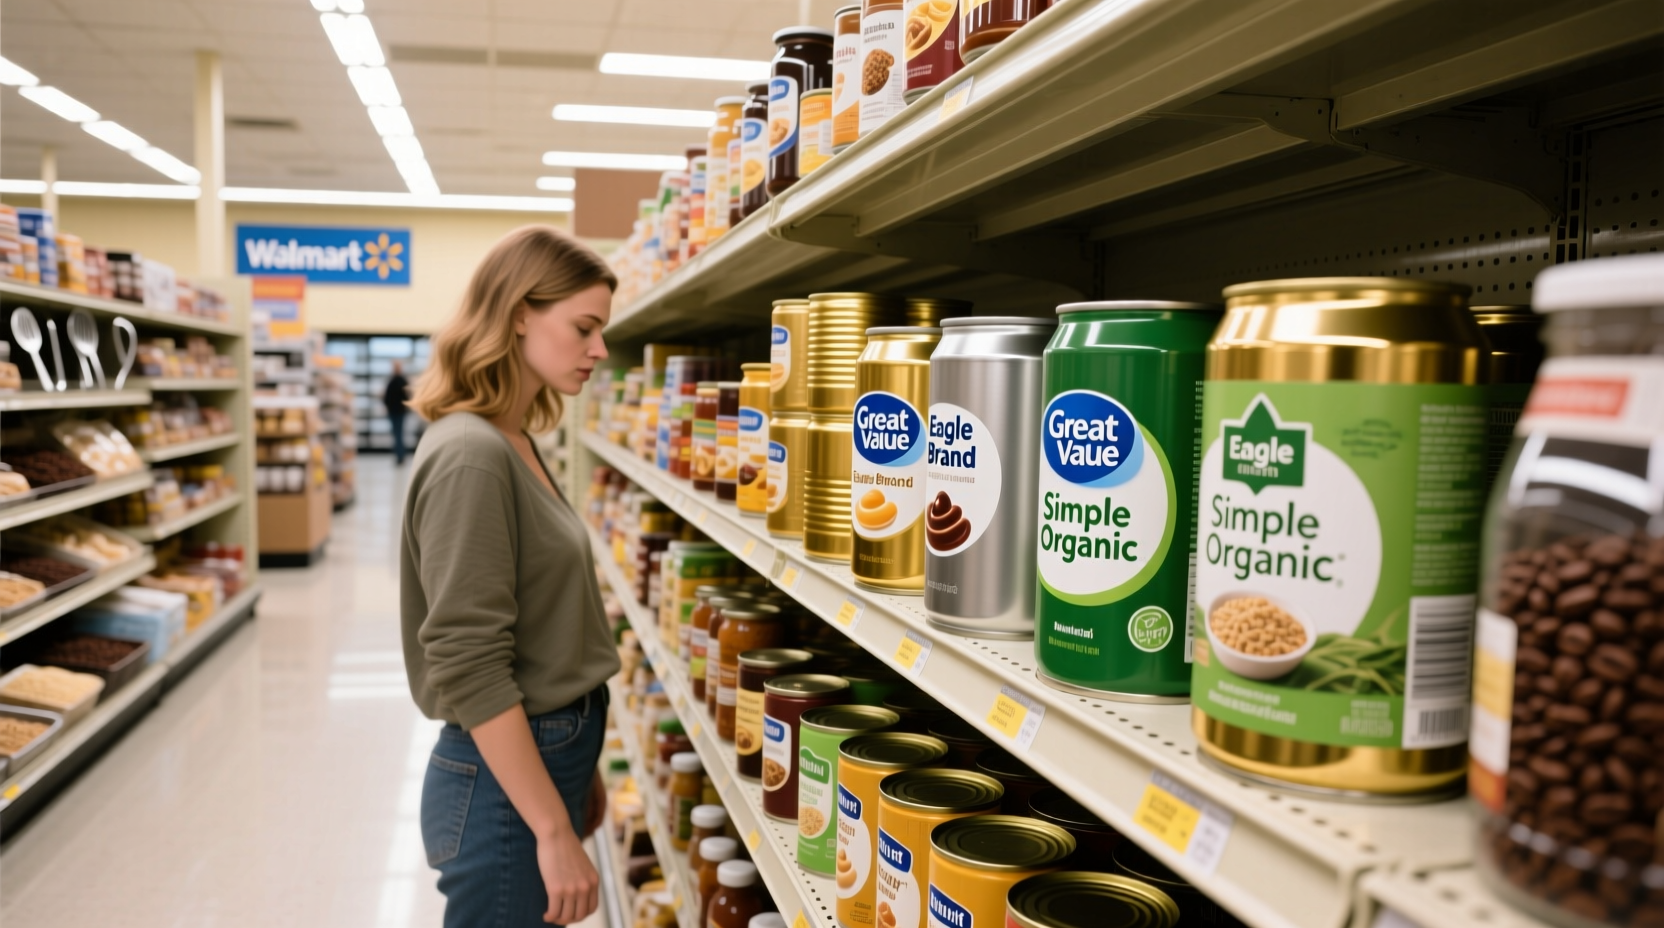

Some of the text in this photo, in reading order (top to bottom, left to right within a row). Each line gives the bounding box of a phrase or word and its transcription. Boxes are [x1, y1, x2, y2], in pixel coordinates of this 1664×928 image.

[244, 238, 363, 272] Walmart
[856, 405, 909, 431] Great
[930, 414, 973, 446] Eagle
[1048, 409, 1119, 442] Great
[861, 429, 910, 451] Value
[928, 441, 977, 469] Brand
[1229, 435, 1294, 469] Eagle
[1043, 491, 1131, 532] Simple
[1211, 493, 1320, 544] Simple
[1041, 523, 1138, 563] Organic
[1206, 532, 1334, 581] Organic
